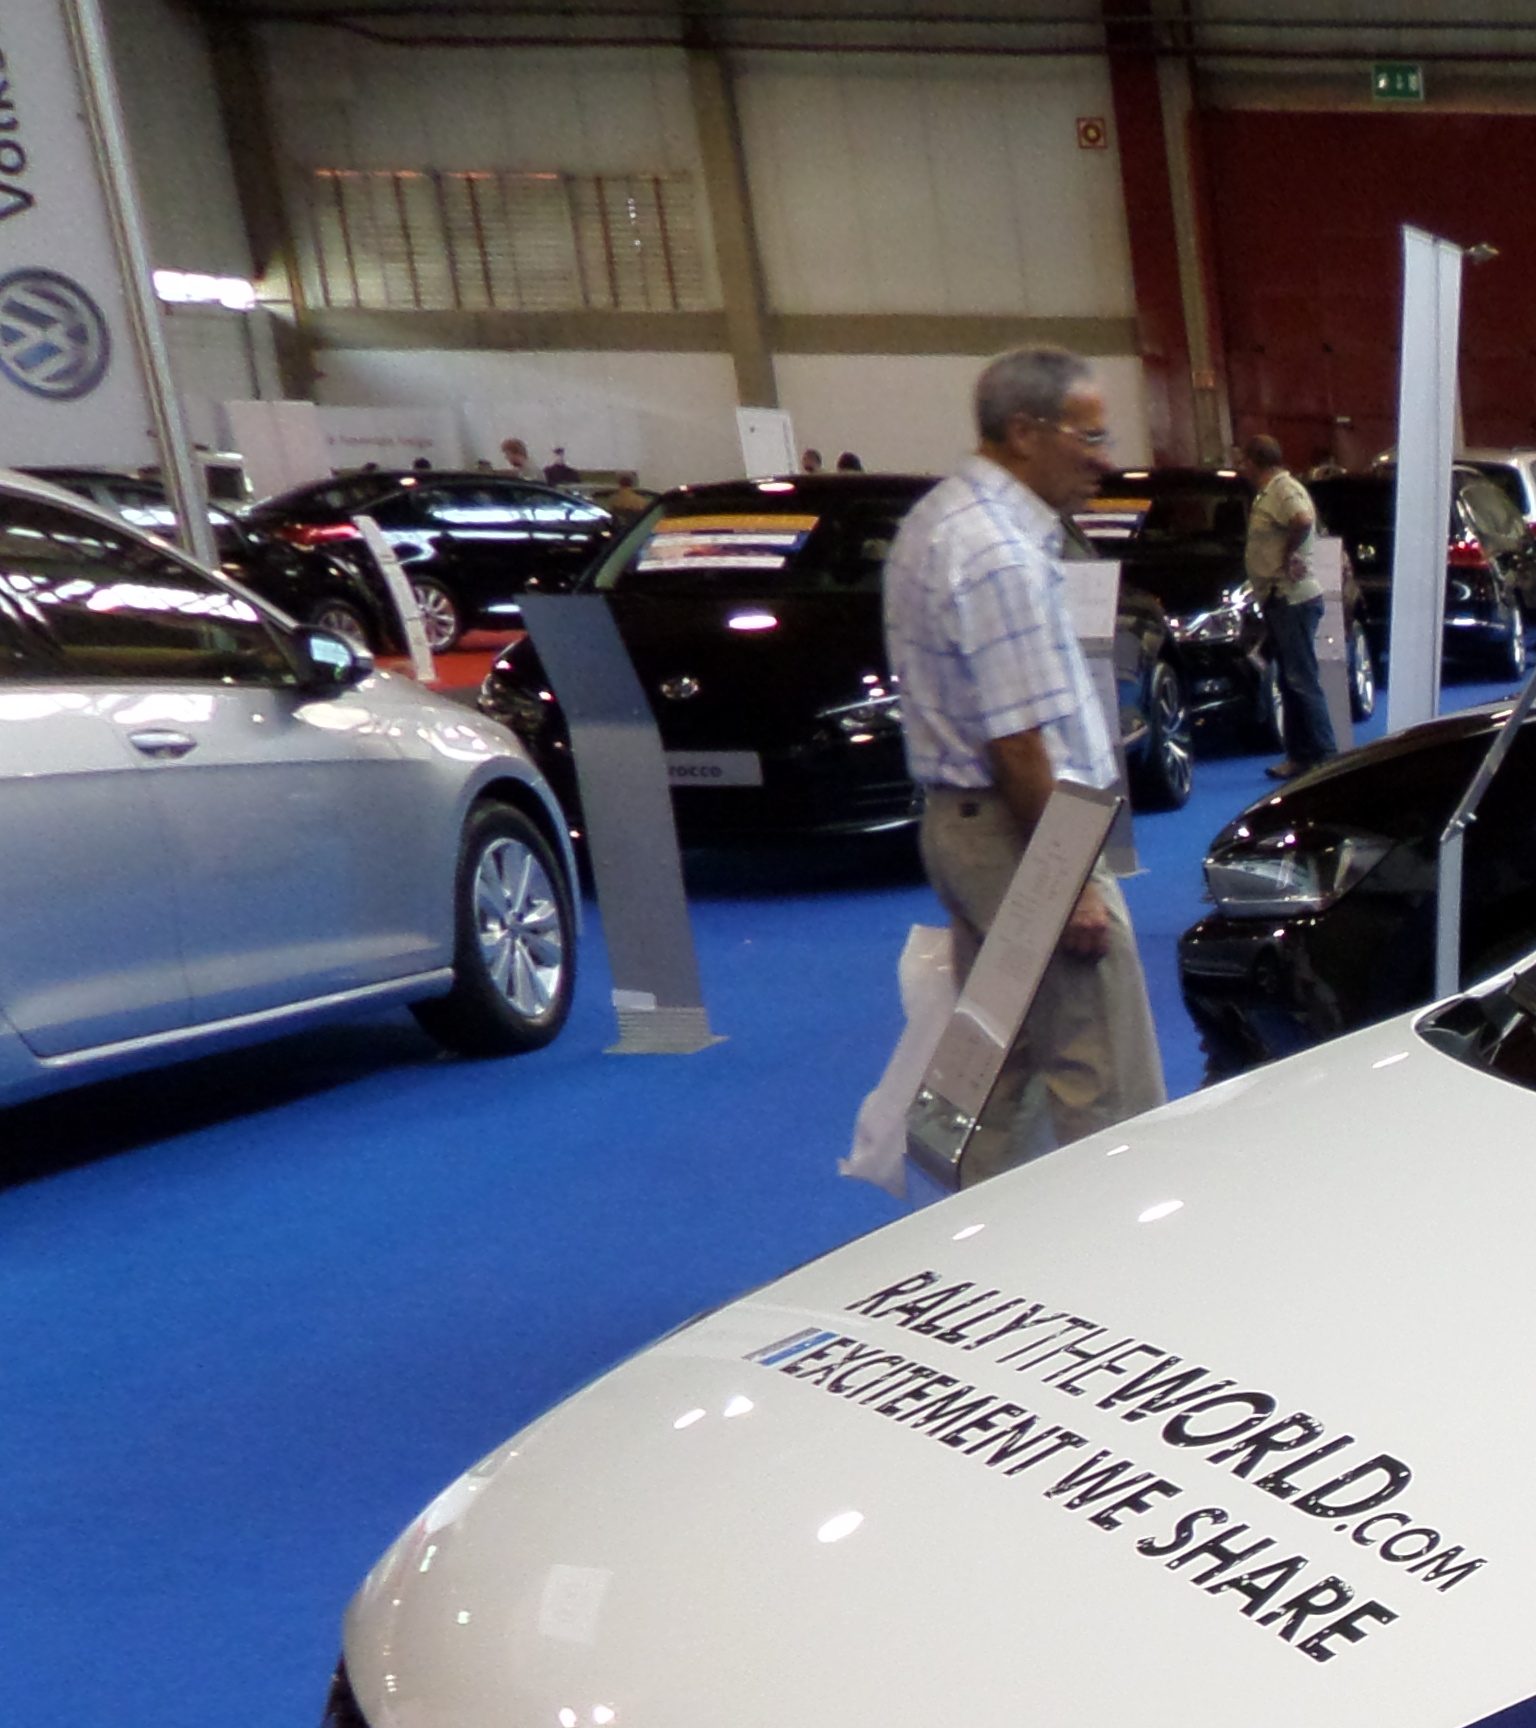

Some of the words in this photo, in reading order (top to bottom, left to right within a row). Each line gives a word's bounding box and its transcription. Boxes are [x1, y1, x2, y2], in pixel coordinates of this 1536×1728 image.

[780, 1336, 1088, 1478] EXCITEMENT
[1044, 1448, 1184, 1532] WE
[1134, 1506, 1400, 1664] SHARE
